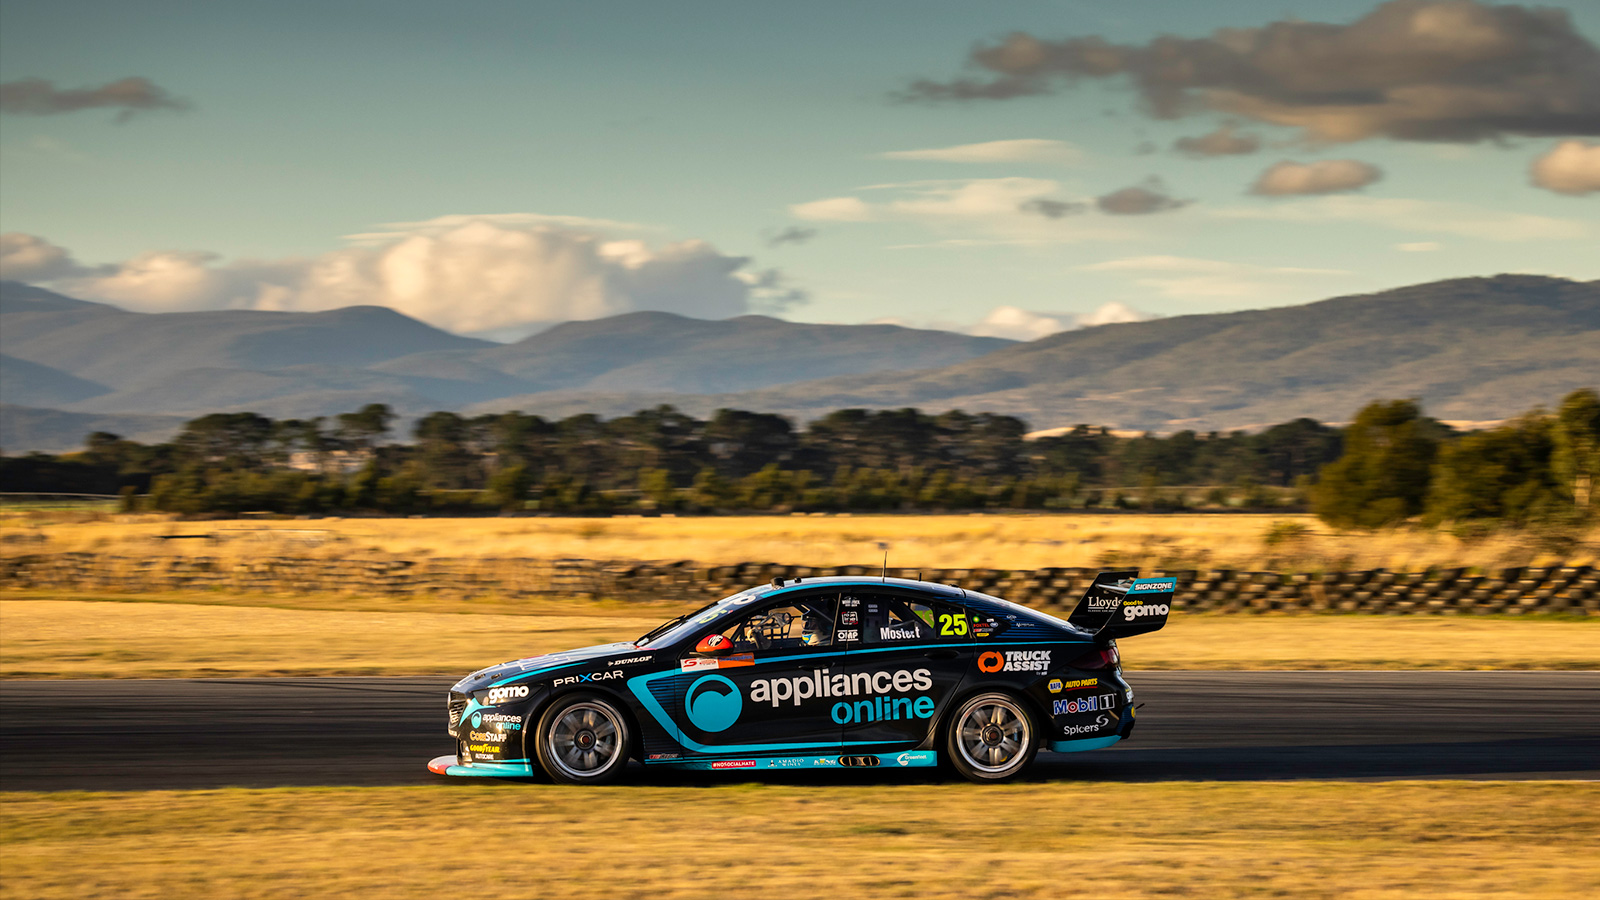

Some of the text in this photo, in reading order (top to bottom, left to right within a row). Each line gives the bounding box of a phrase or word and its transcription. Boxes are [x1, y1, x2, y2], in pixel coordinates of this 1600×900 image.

[1134, 582, 1173, 591] SIGNZONE
[1123, 604, 1169, 621] gomo
[939, 614, 967, 635] 25
[614, 655, 652, 666] DUNLOP
[1005, 651, 1051, 661] TRUCK
[1003, 661, 1050, 671] ASSIST
[553, 670, 624, 687] PRIXCAR
[1065, 680, 1081, 689] AUTO
[750, 668, 933, 707] appliances
[489, 686, 529, 704] gomo
[831, 696, 935, 724] online
[1053, 696, 1098, 715] Mobil
[482, 712, 522, 723] appliances
[495, 721, 522, 731] online
[1063, 724, 1100, 736] Spicers
